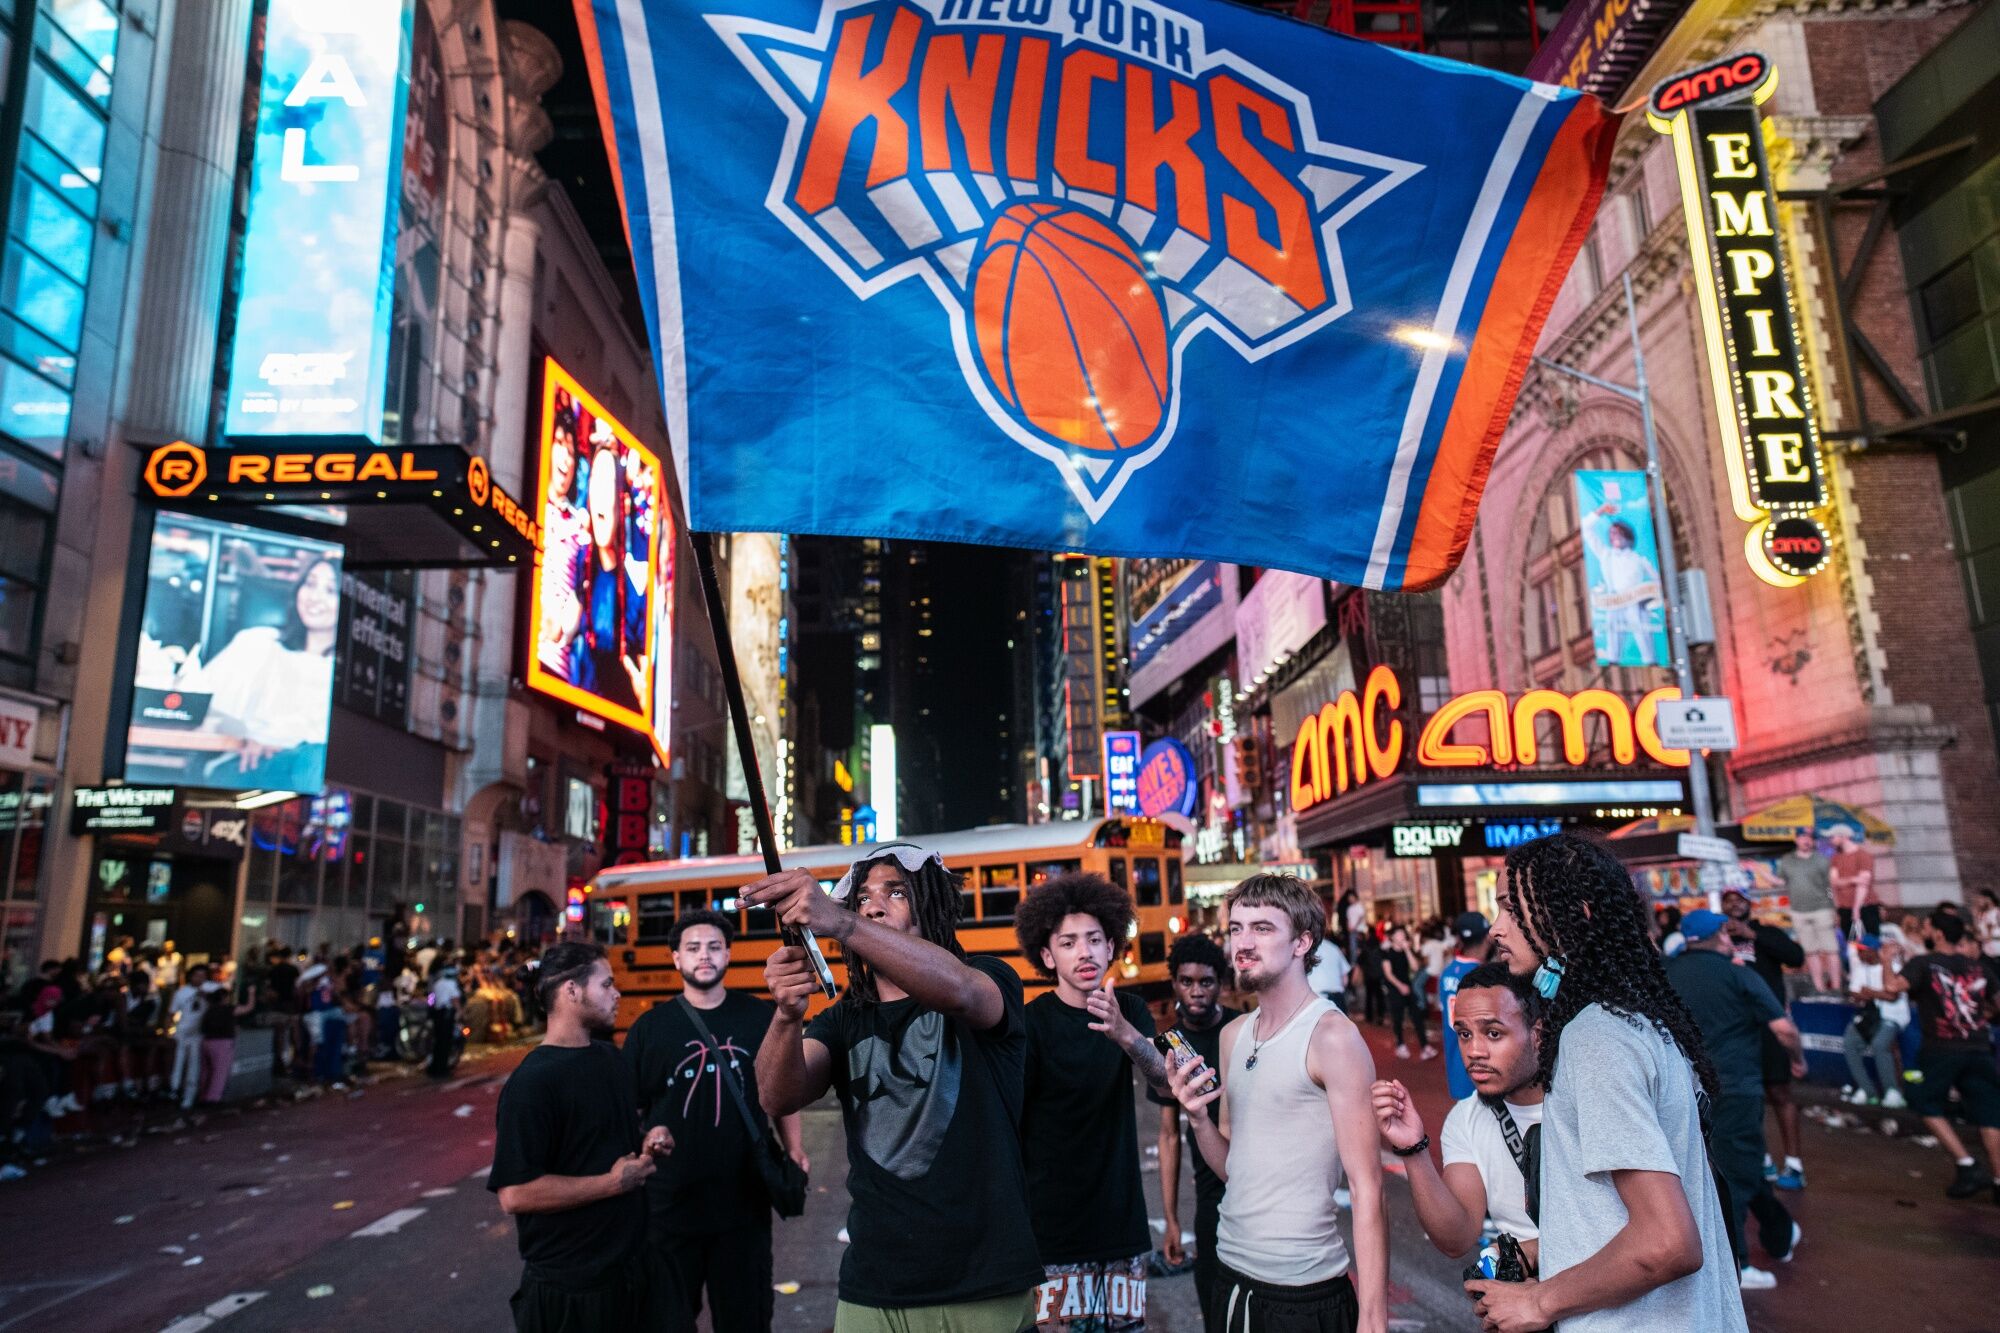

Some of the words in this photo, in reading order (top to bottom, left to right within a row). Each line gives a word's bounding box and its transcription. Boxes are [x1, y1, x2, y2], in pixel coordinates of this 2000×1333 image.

[1069, 0, 1193, 74] YORK
[794, 3, 1327, 312] KNICKS
[1707, 133, 1811, 484] EMPIRE
[228, 453, 439, 484] REGAL
[1110, 755, 1134, 775] EAT
[74, 789, 109, 807] THE
[108, 788, 174, 806] WESTIN
[1392, 825, 1464, 847] DOLBY
[1036, 1274, 1147, 1322] FAMOU
